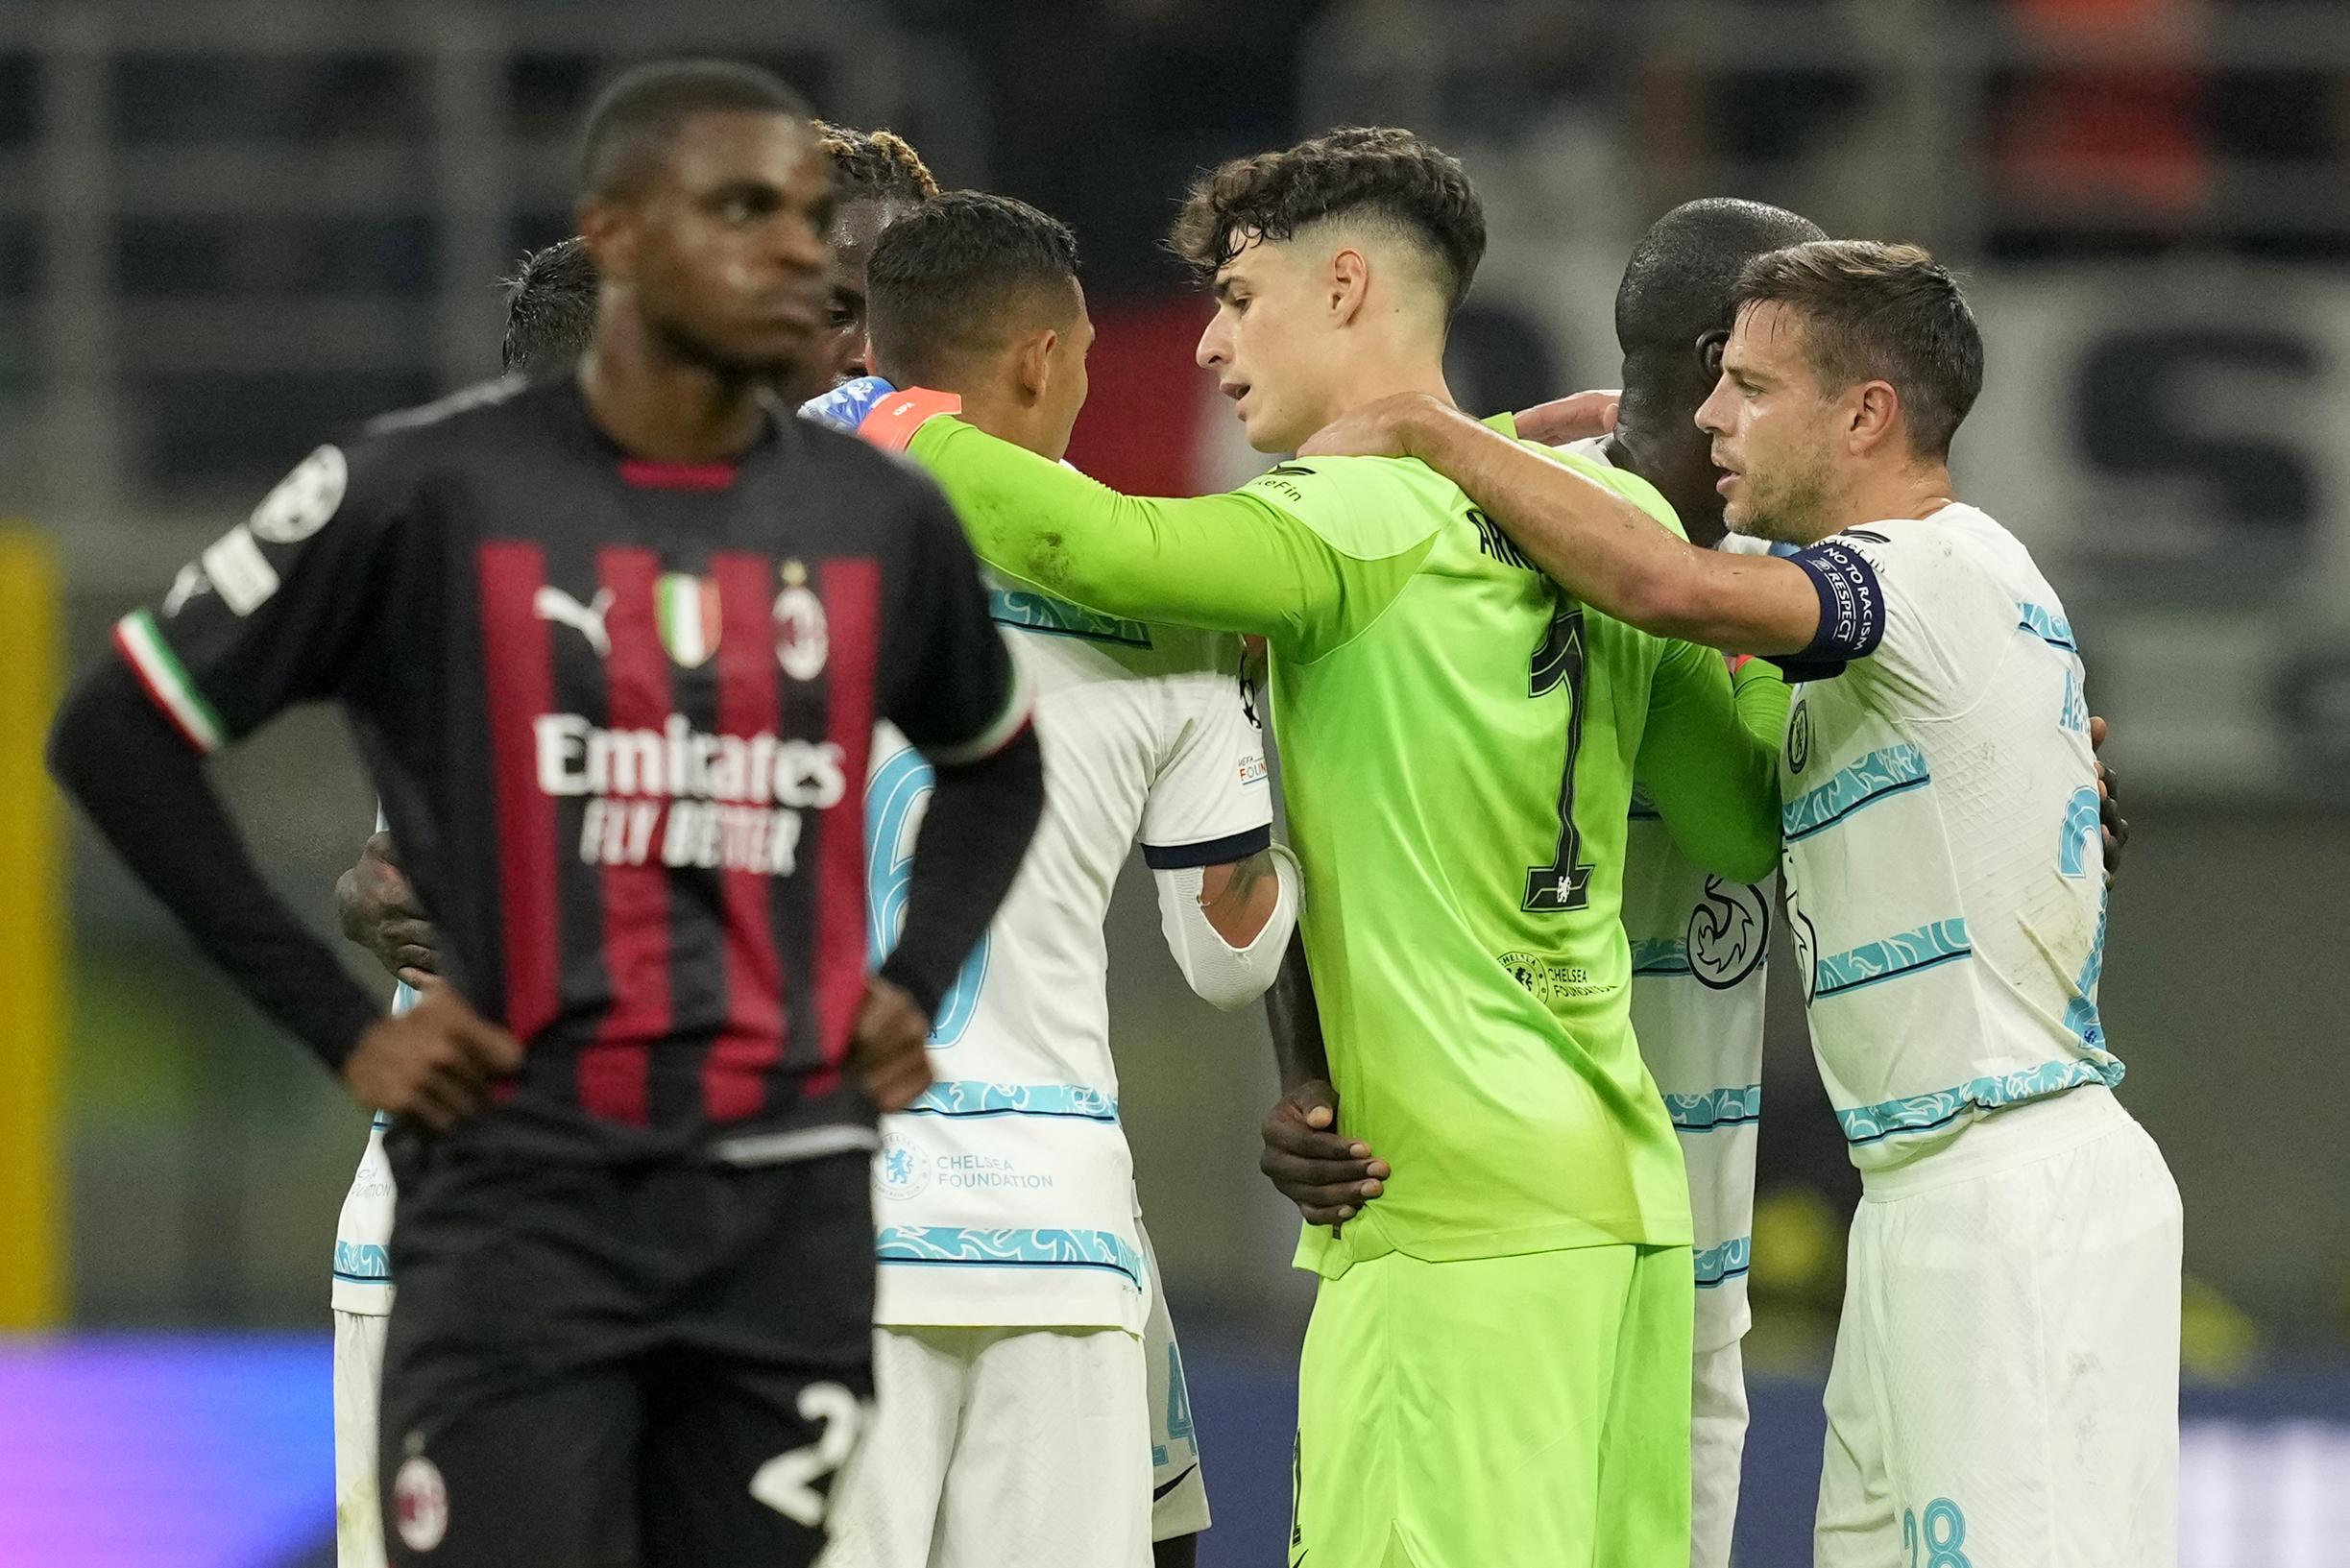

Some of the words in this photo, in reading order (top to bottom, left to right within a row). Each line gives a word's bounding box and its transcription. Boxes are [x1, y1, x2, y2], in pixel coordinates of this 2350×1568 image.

[1823, 547, 1849, 565] NO
[1845, 564, 1864, 585] TO
[1829, 572, 1853, 641] RESPECT
[1853, 586, 1873, 651] RACISM
[534, 712, 847, 809] Emirates
[1521, 603, 1596, 912] 1
[1547, 968, 1587, 983] CHELSEA
[936, 1155, 1014, 1171] CHELSEA
[938, 1173, 1054, 1189] FOUNDATION
